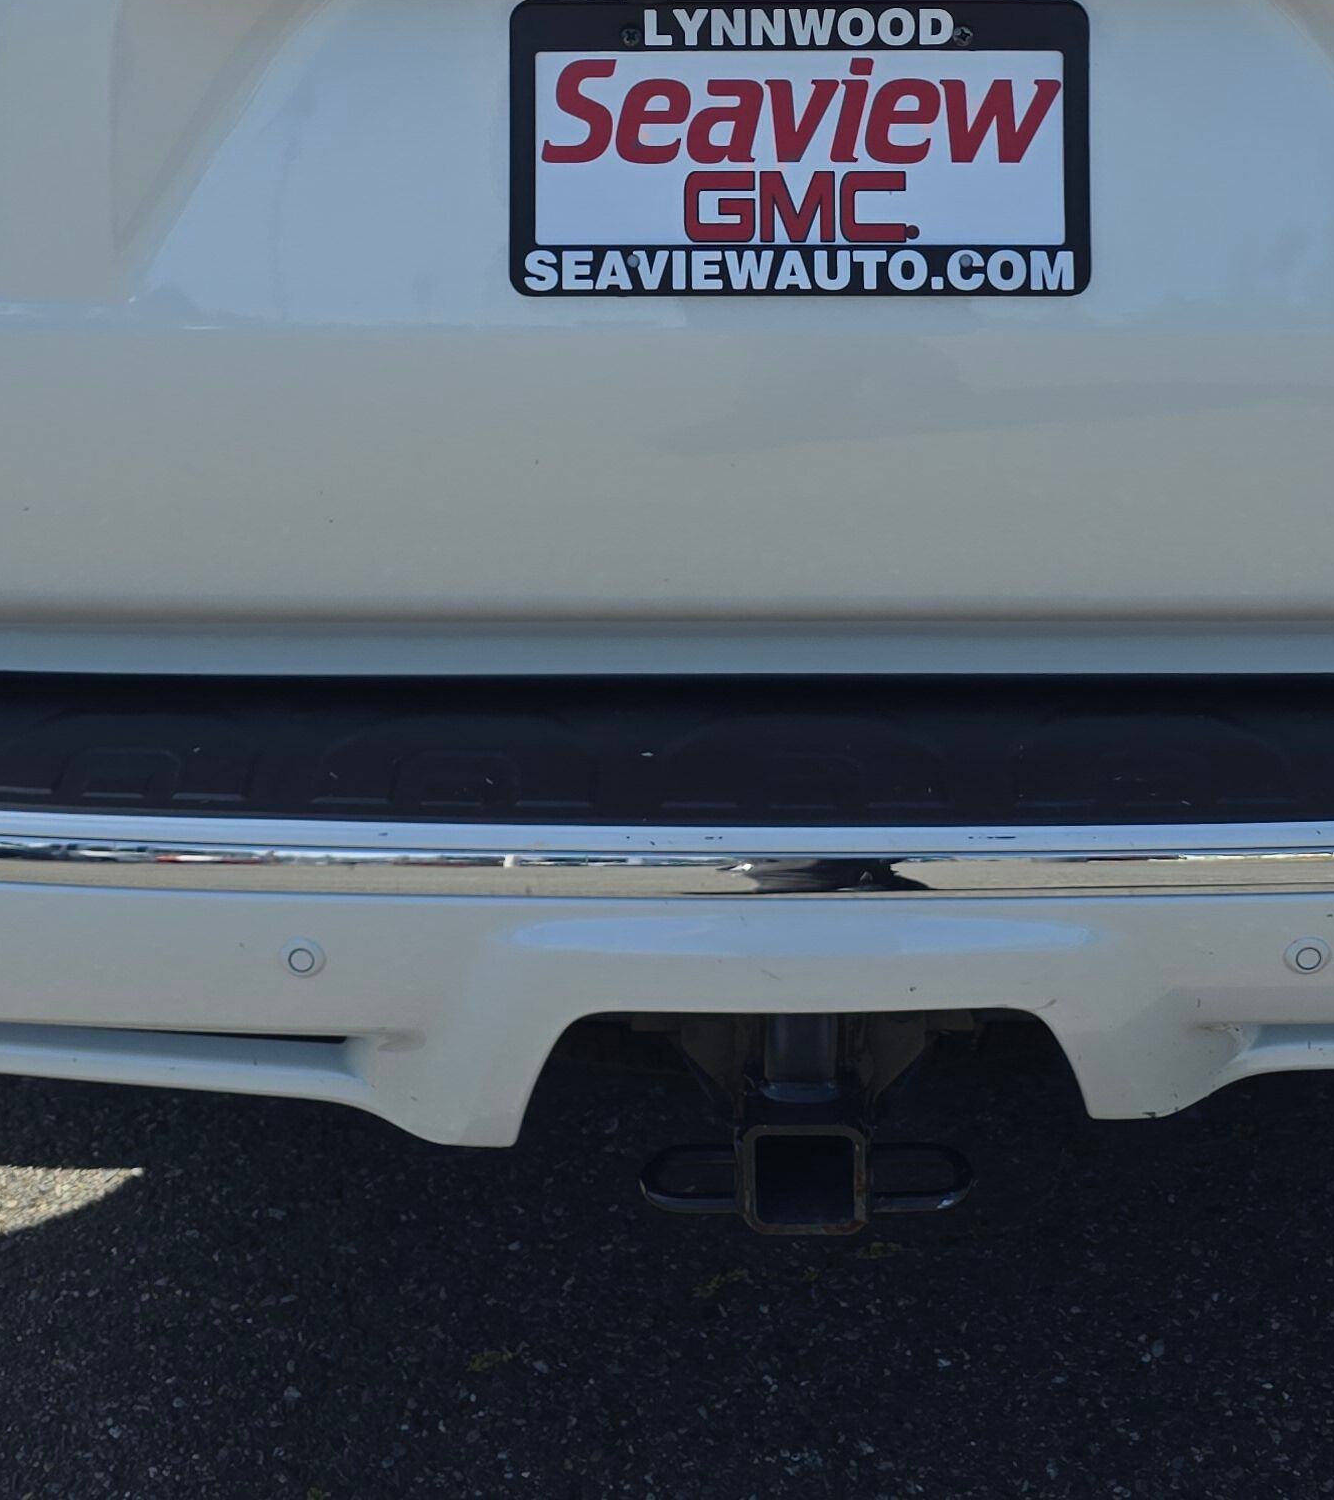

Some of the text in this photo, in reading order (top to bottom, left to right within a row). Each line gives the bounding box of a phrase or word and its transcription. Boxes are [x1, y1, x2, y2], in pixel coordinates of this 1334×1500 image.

[643, 7, 955, 47] LYNNWOOD
[541, 57, 1062, 164] Seaview
[683, 170, 907, 243] GMC
[523, 250, 1075, 292] SEAVIEWAUTO.COM
